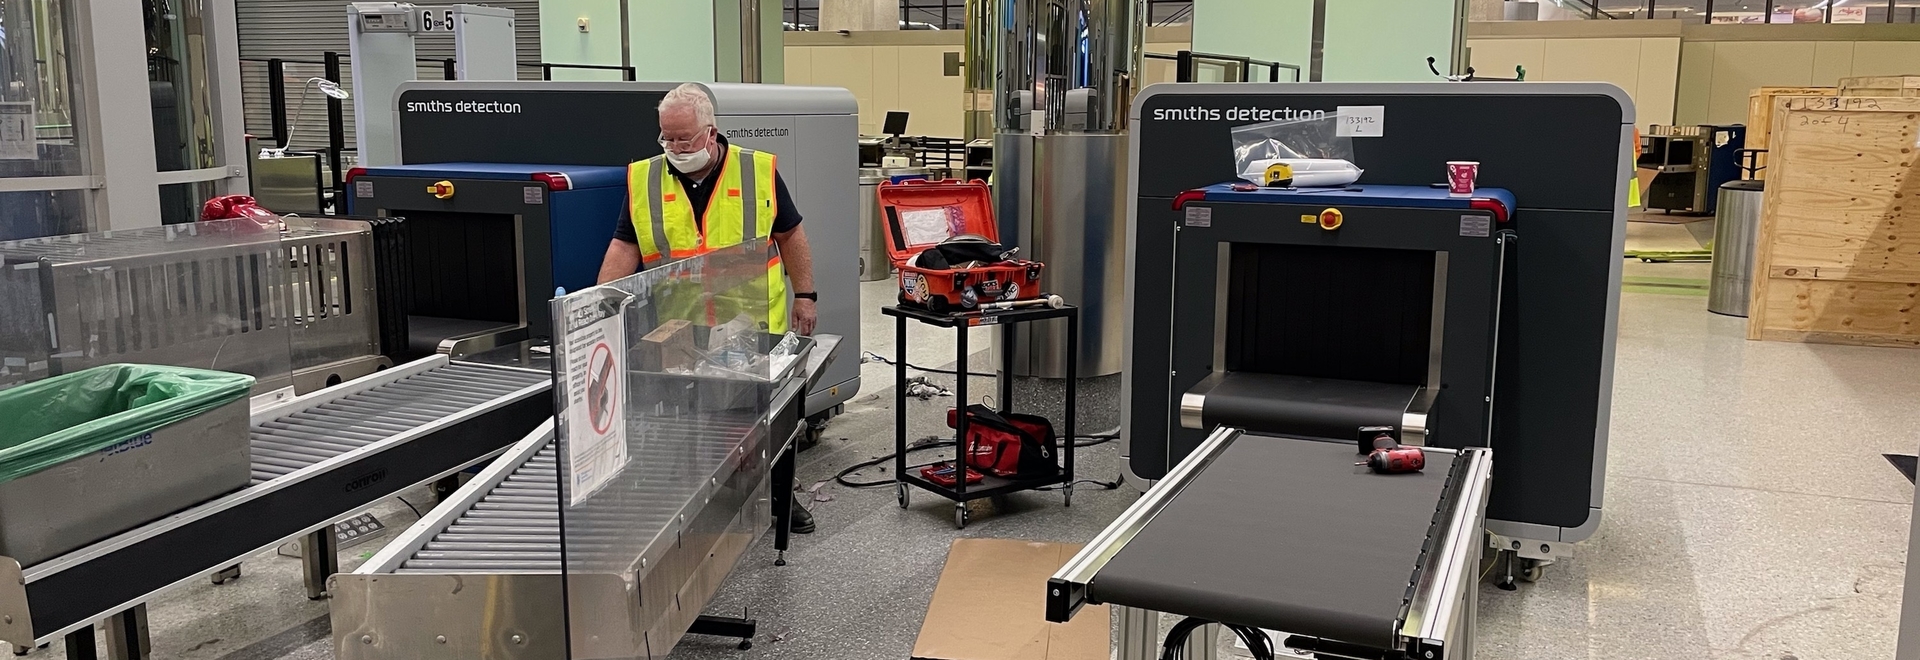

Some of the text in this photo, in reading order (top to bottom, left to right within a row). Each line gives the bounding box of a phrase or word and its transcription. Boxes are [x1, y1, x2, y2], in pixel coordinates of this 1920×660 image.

[423, 11, 454, 31] 6 5
[407, 100, 522, 114] smiths detection
[1153, 106, 1325, 122] smiths detection
[1345, 116, 1375, 125] 133192
[1838, 116, 1850, 133] 4
[726, 127, 789, 139] smiths detection
[100, 433, 153, 462] tBlue
